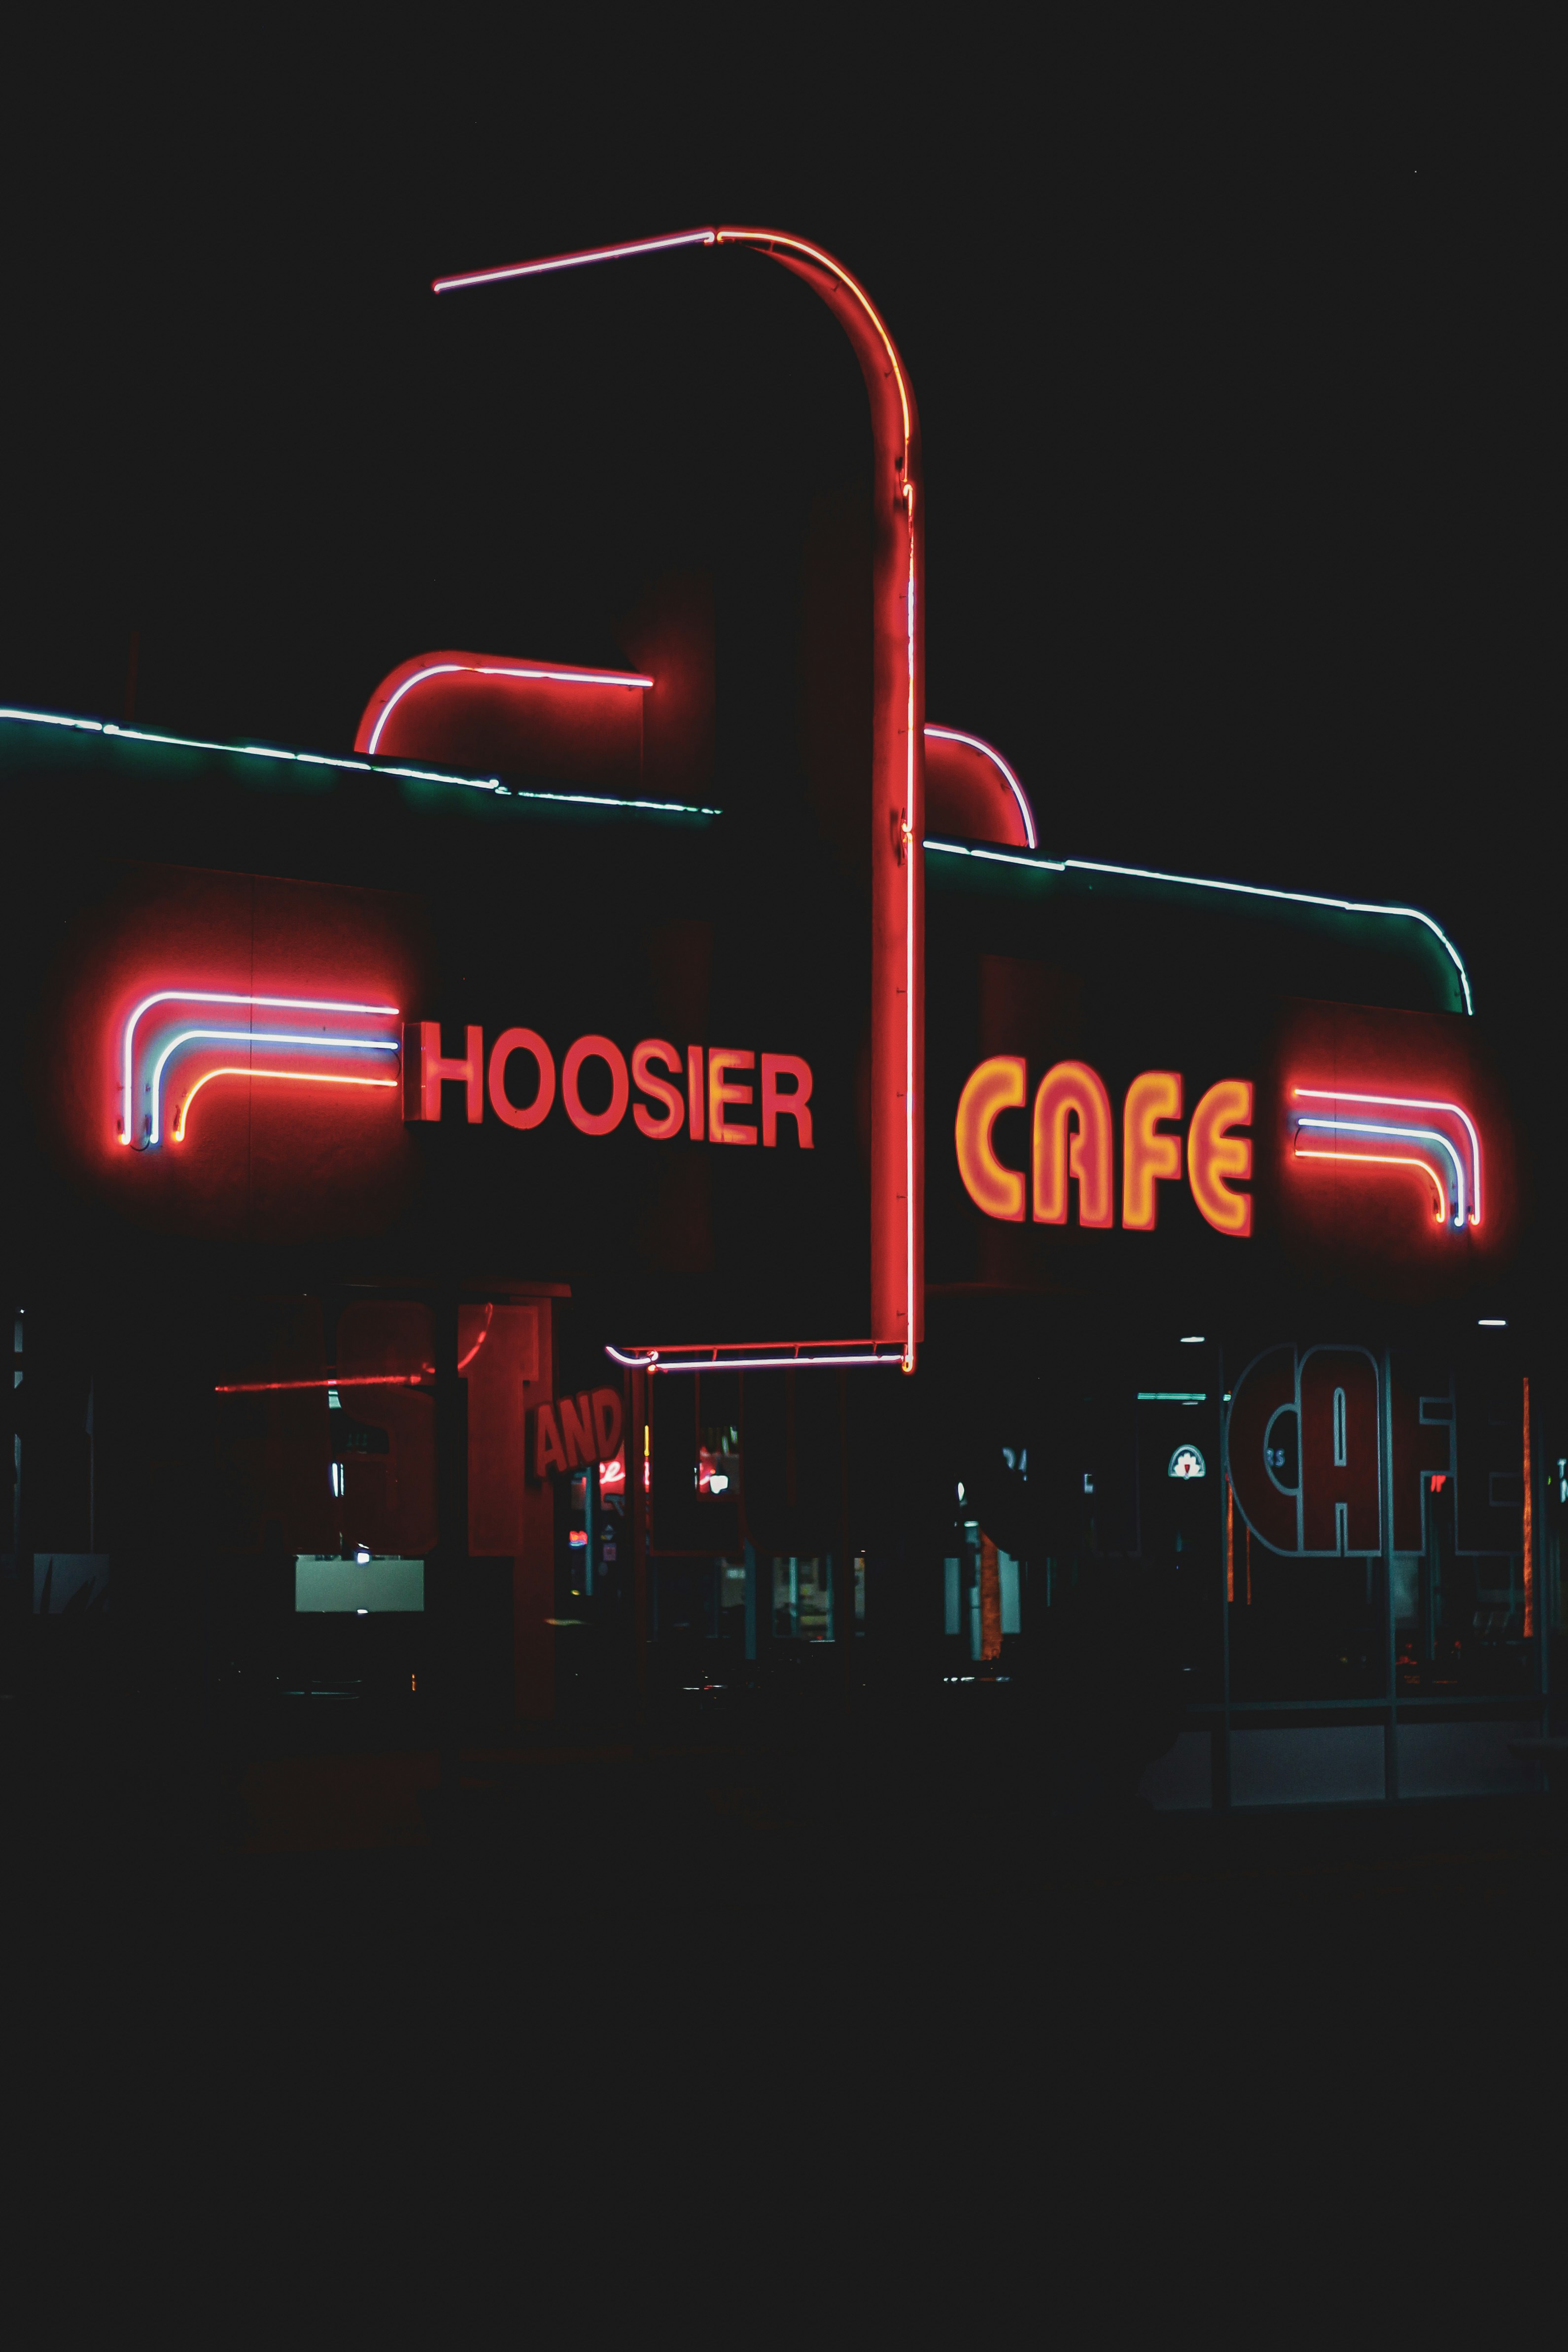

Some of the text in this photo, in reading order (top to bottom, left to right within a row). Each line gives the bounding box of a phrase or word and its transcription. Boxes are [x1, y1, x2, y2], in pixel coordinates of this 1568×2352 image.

[420, 1020, 1253, 1238] HOOSIER CAFE
[535, 1386, 623, 1479] AND
